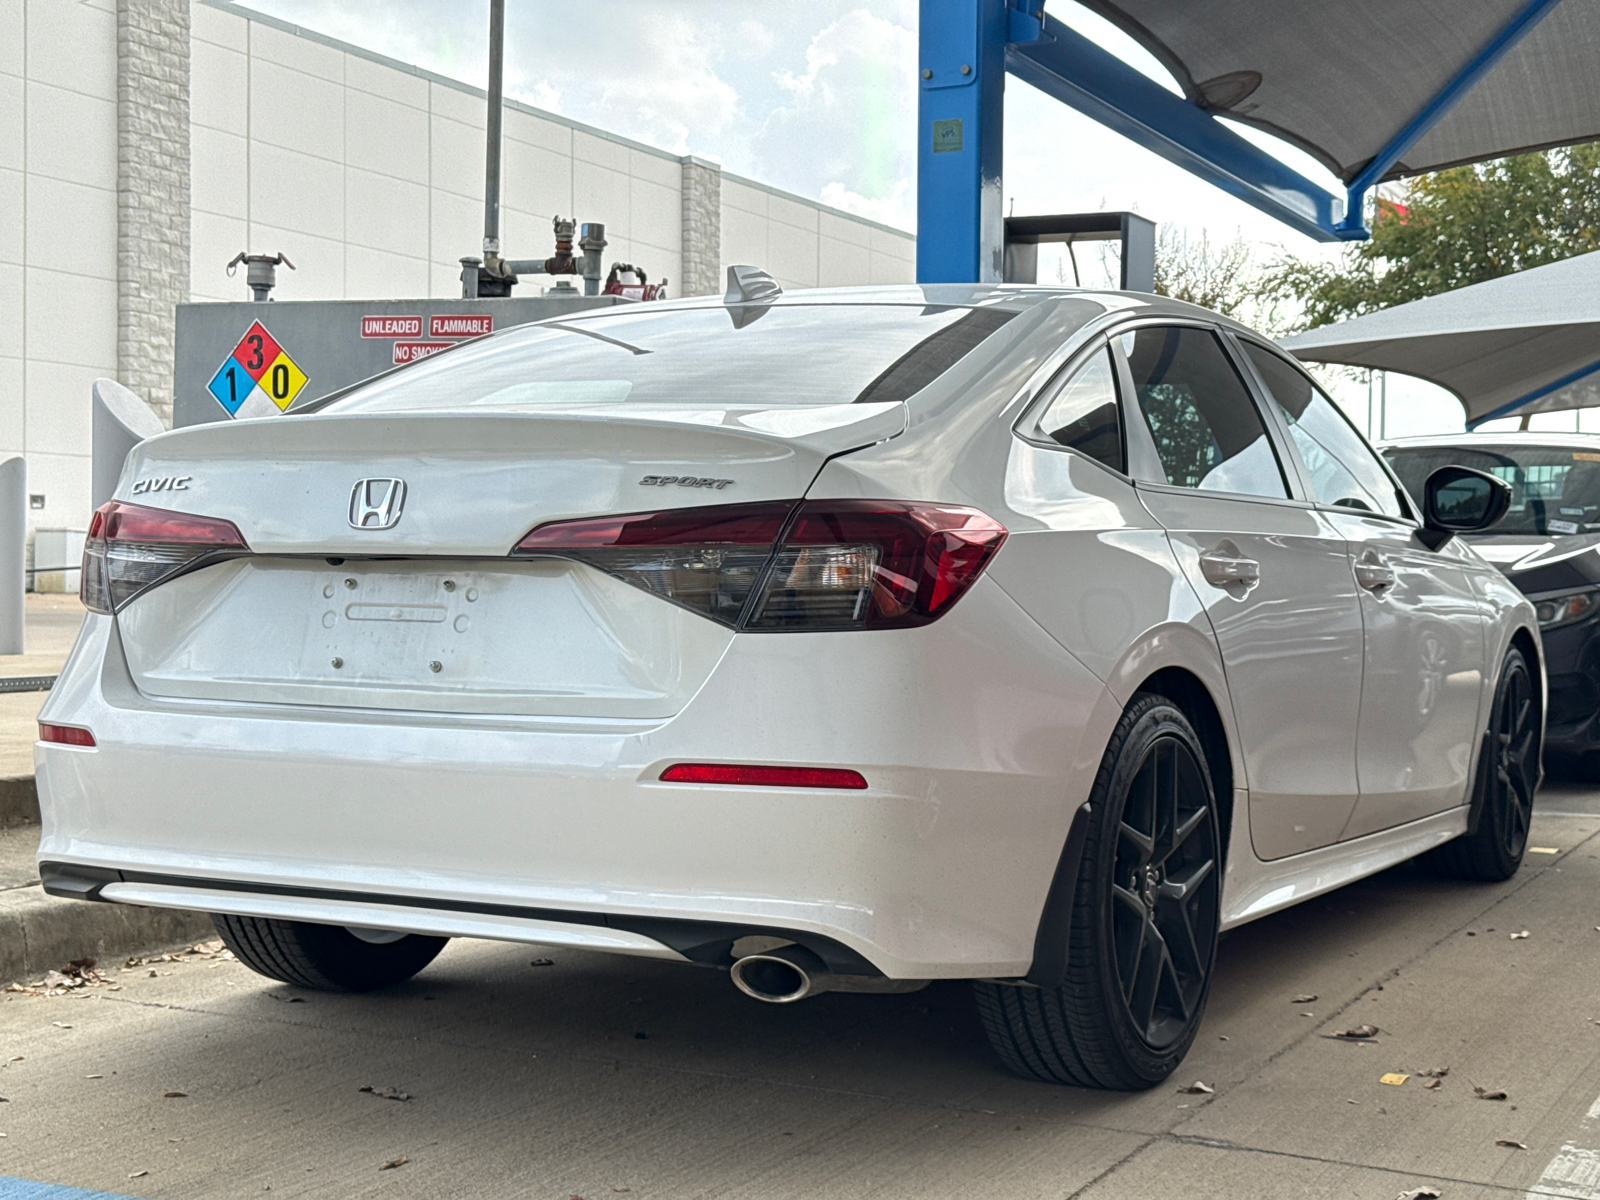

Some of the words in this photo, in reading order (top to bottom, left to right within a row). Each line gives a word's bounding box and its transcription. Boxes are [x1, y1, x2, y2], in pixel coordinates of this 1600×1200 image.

[364, 320, 419, 334] UNLEADED
[432, 319, 489, 333] FLAMMABLE
[246, 334, 264, 370] 3
[395, 346, 410, 360] NO
[411, 346, 446, 360] SMOK
[225, 366, 237, 402] 1
[272, 364, 289, 399] 0
[131, 476, 192, 495] CIVIC
[638, 475, 735, 490] SPORT
